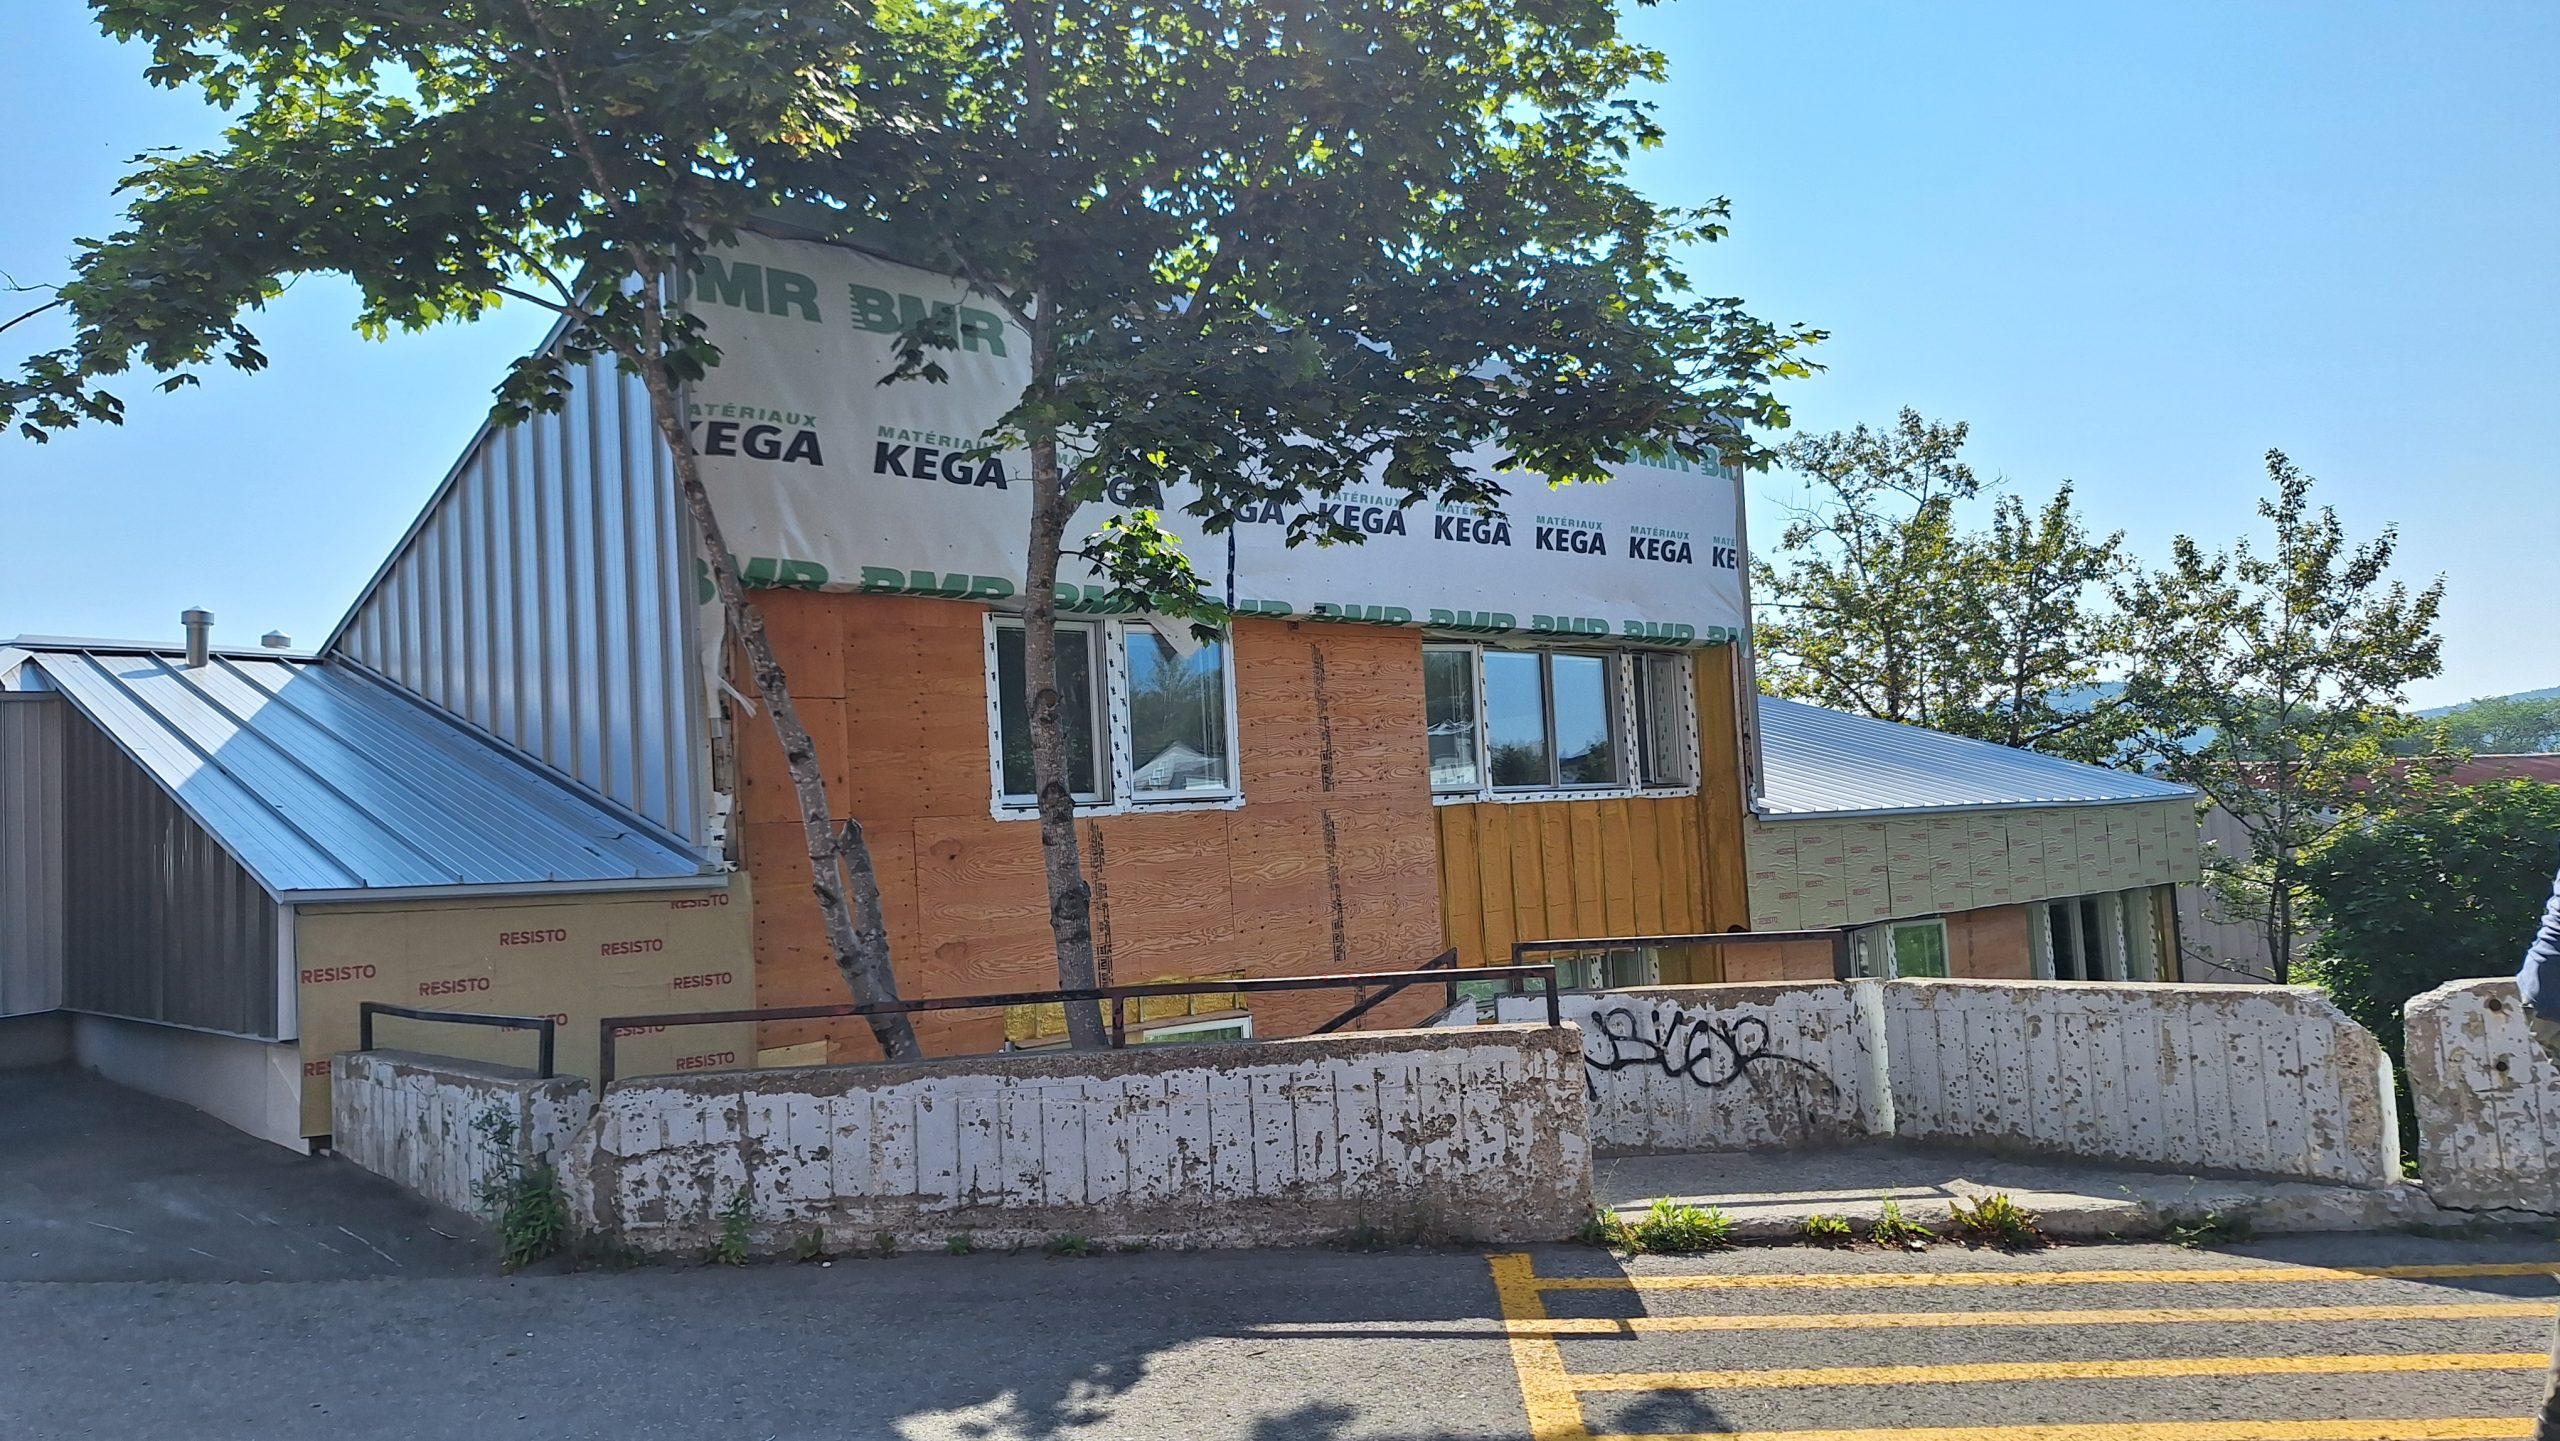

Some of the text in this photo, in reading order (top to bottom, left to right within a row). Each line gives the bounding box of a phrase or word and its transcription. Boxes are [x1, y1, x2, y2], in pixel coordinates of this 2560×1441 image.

[688, 402, 817, 428] ATÉRIAUX
[873, 441, 1008, 490] KEGA
[1316, 501, 1407, 537] KEGA
[1536, 515, 1603, 531] MATÉRIAUX
[1434, 514, 1512, 547] KEGA
[1630, 525, 1690, 540] MATÉRIAUX
[1535, 526, 1607, 556] KEGA
[1629, 536, 1693, 564] KEGA
[1712, 546, 1739, 570] KE
[499, 928, 567, 947] RESISTO
[600, 938, 664, 956] RESISTO
[300, 964, 377, 984] RESISTO
[673, 972, 733, 990] RESISTO
[418, 977, 491, 996] RESISTO
[676, 1051, 736, 1070] RESISTO
